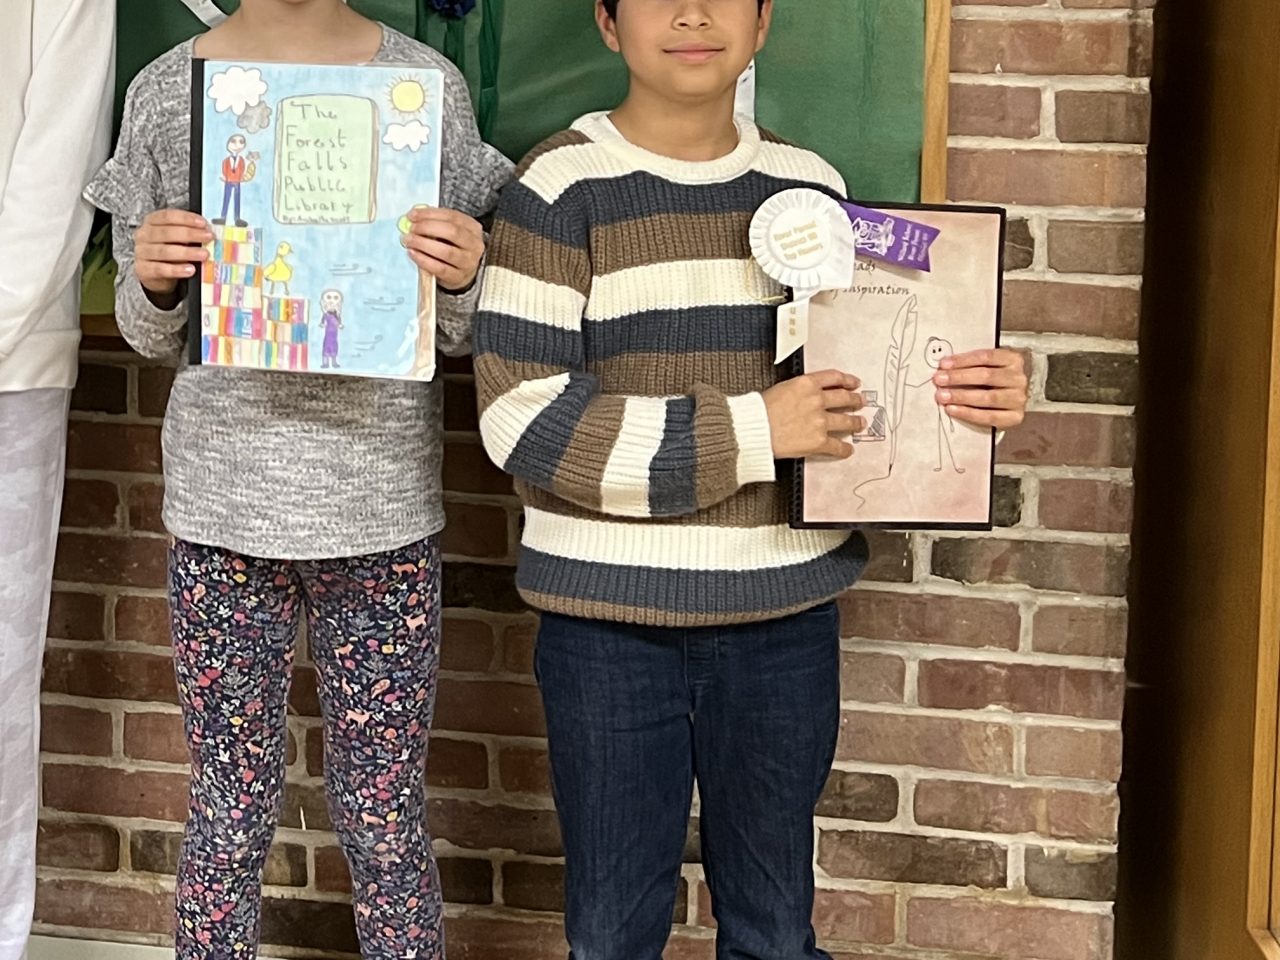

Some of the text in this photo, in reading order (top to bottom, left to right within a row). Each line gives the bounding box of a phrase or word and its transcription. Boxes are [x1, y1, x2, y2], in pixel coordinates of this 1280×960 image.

[290, 100, 337, 119] The
[286, 125, 347, 148] Forest
[287, 151, 347, 171] Falls
[284, 176, 346, 192] Public
[284, 194, 353, 213] Library
